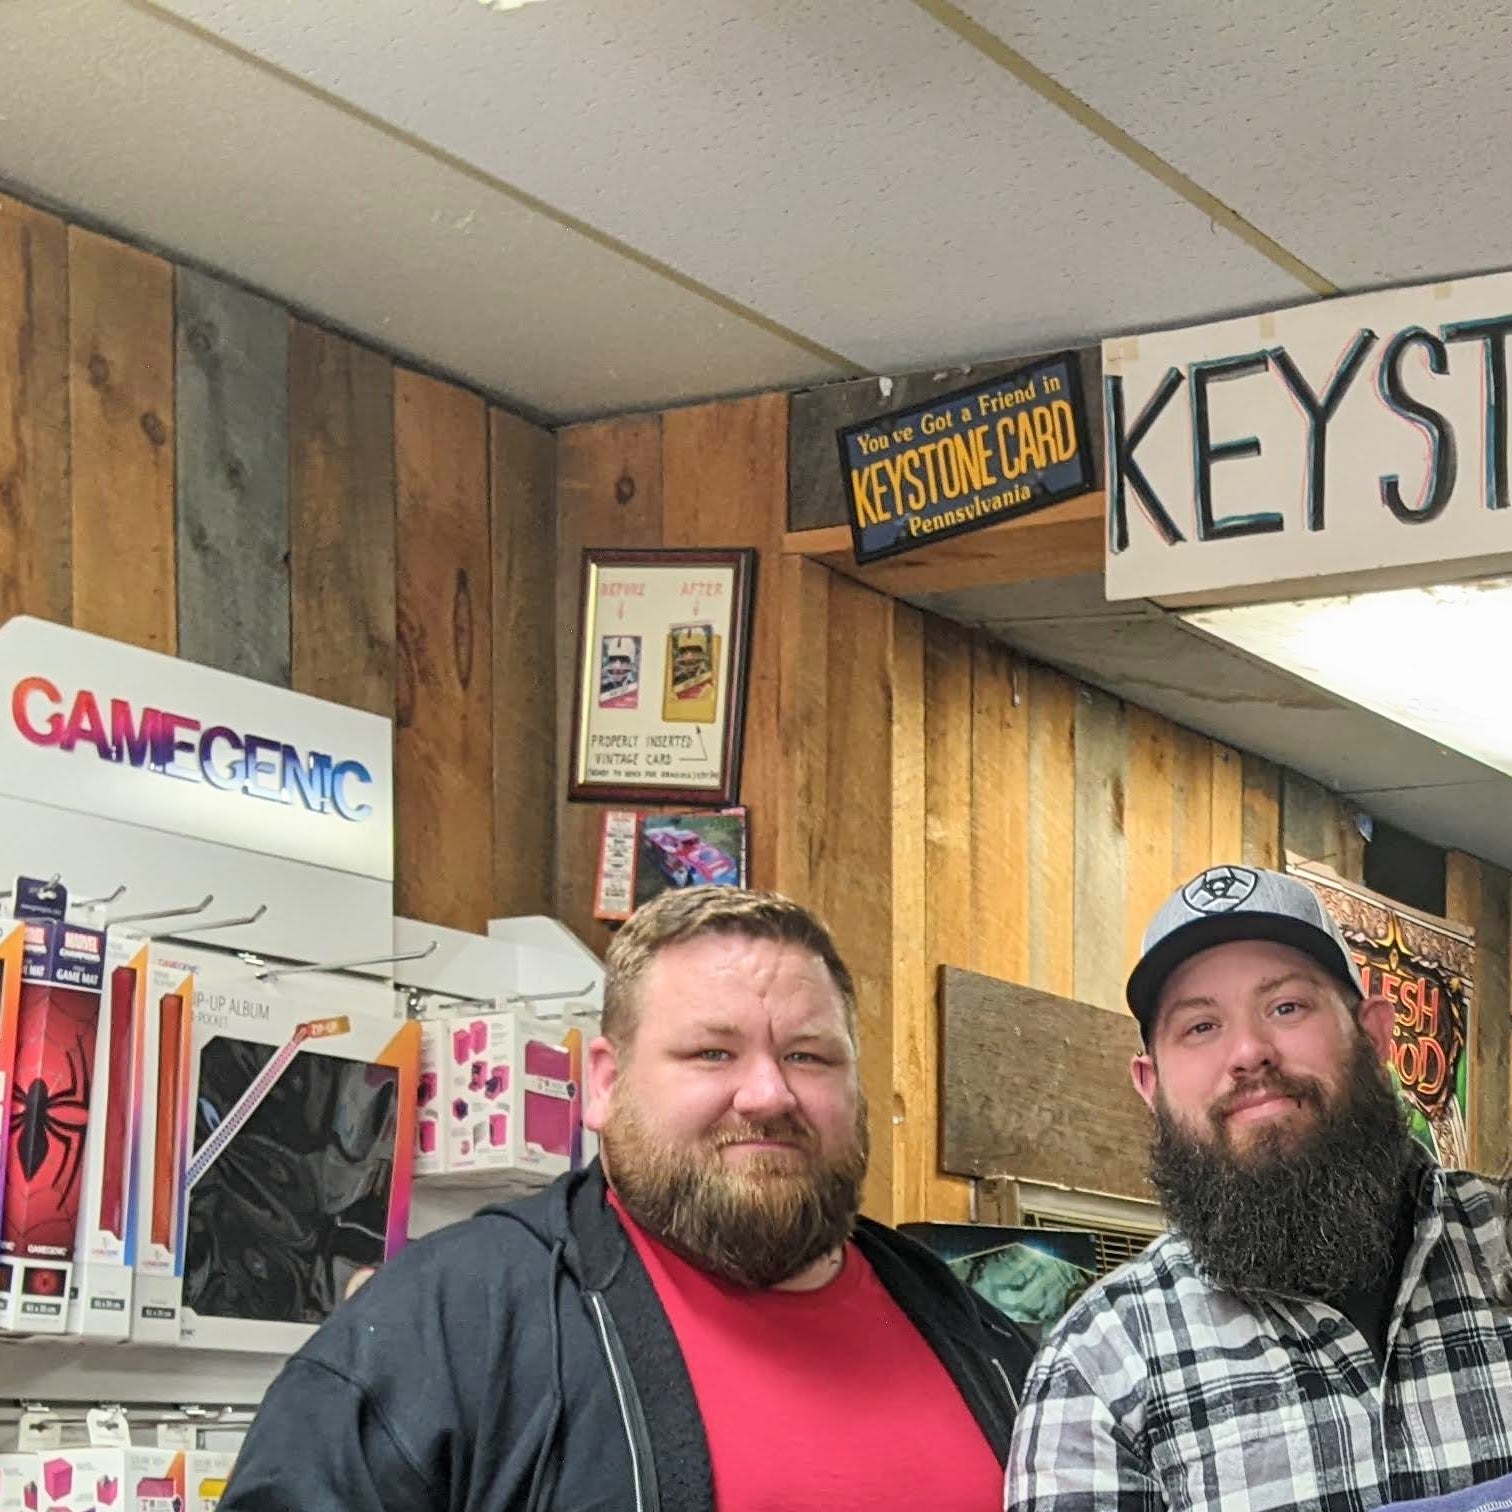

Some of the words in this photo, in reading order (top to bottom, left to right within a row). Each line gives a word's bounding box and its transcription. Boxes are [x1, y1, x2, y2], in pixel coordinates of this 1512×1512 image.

[920, 410, 953, 436] Got
[961, 408, 972, 422] a
[978, 382, 1036, 416] Friend
[1042, 376, 1061, 395] in
[850, 424, 997, 529] KEYSTONE
[996, 399, 1078, 480] CARD
[908, 483, 1032, 537] Pennsylvania
[600, 583, 646, 597] BEFORE
[680, 582, 723, 597] AFTER
[11, 676, 373, 822] GAMEGENIC
[591, 734, 638, 748] PROPERLY
[646, 734, 693, 749] INSERTED
[595, 753, 639, 766] VINTAGE
[645, 753, 673, 766] CARD
[56, 968, 80, 983] GAME
[82, 972, 98, 986] MAT
[229, 999, 269, 1020] ALBUM
